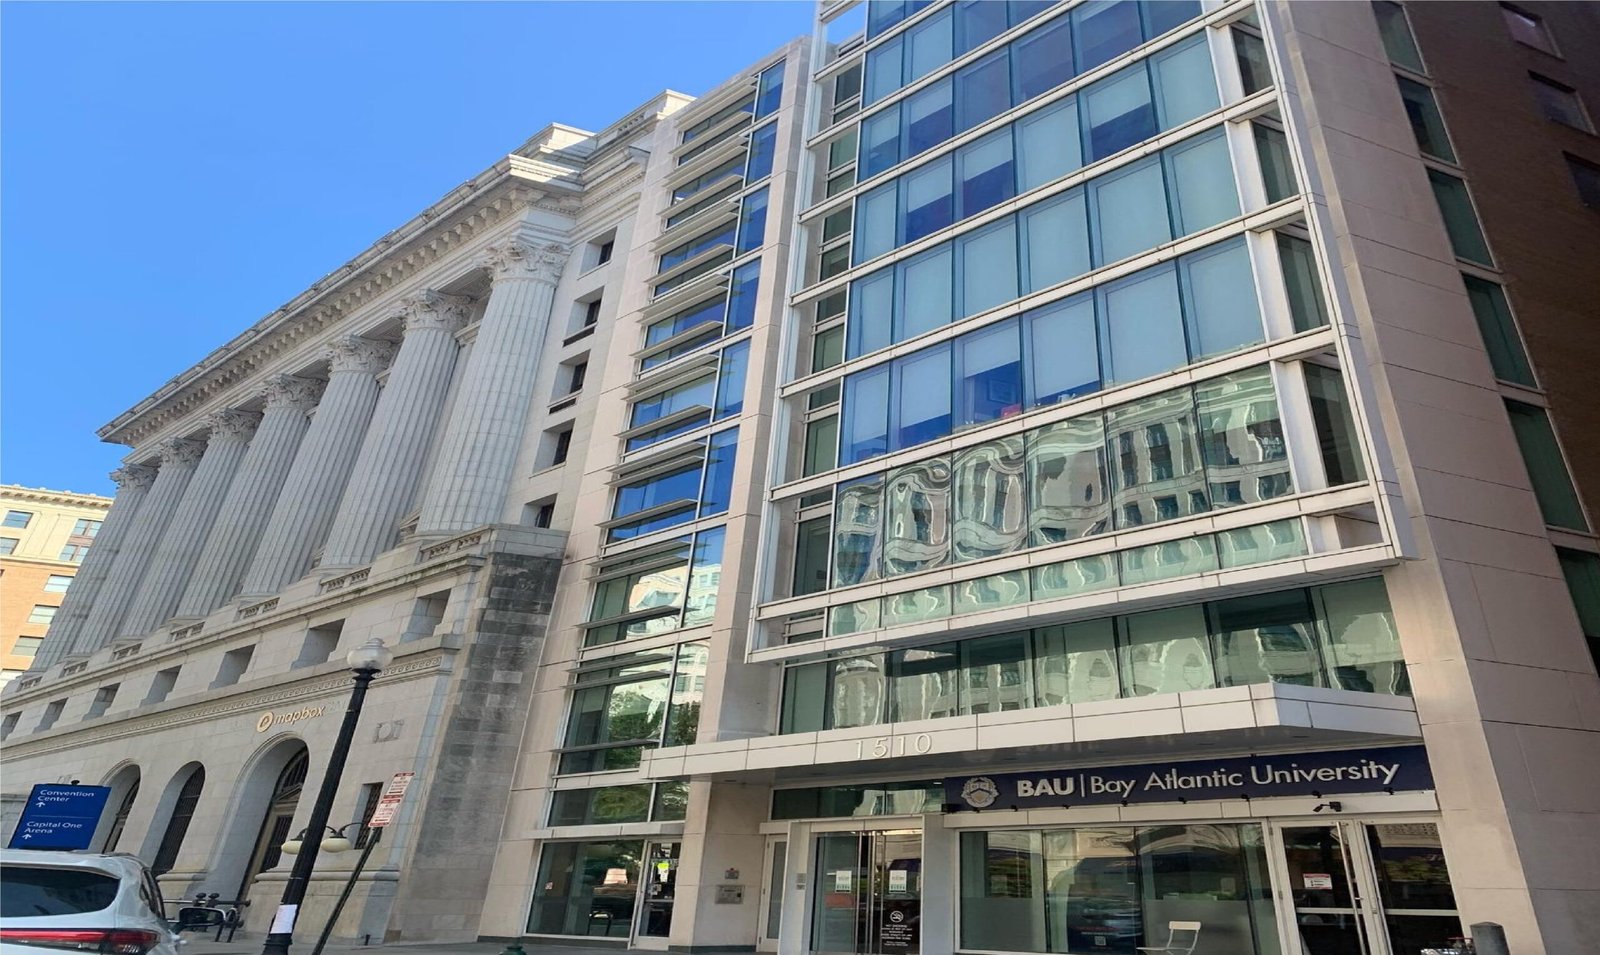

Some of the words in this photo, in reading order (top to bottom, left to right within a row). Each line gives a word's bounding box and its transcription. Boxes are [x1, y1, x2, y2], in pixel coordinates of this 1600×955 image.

[273, 706, 326, 725] mapbox
[856, 733, 932, 759] 1510
[1016, 777, 1075, 798] BAU
[1090, 775, 1136, 798] Bay
[1143, 768, 1244, 791] Atlantic
[1250, 759, 1400, 785] University
[40, 789, 95, 797] Convention
